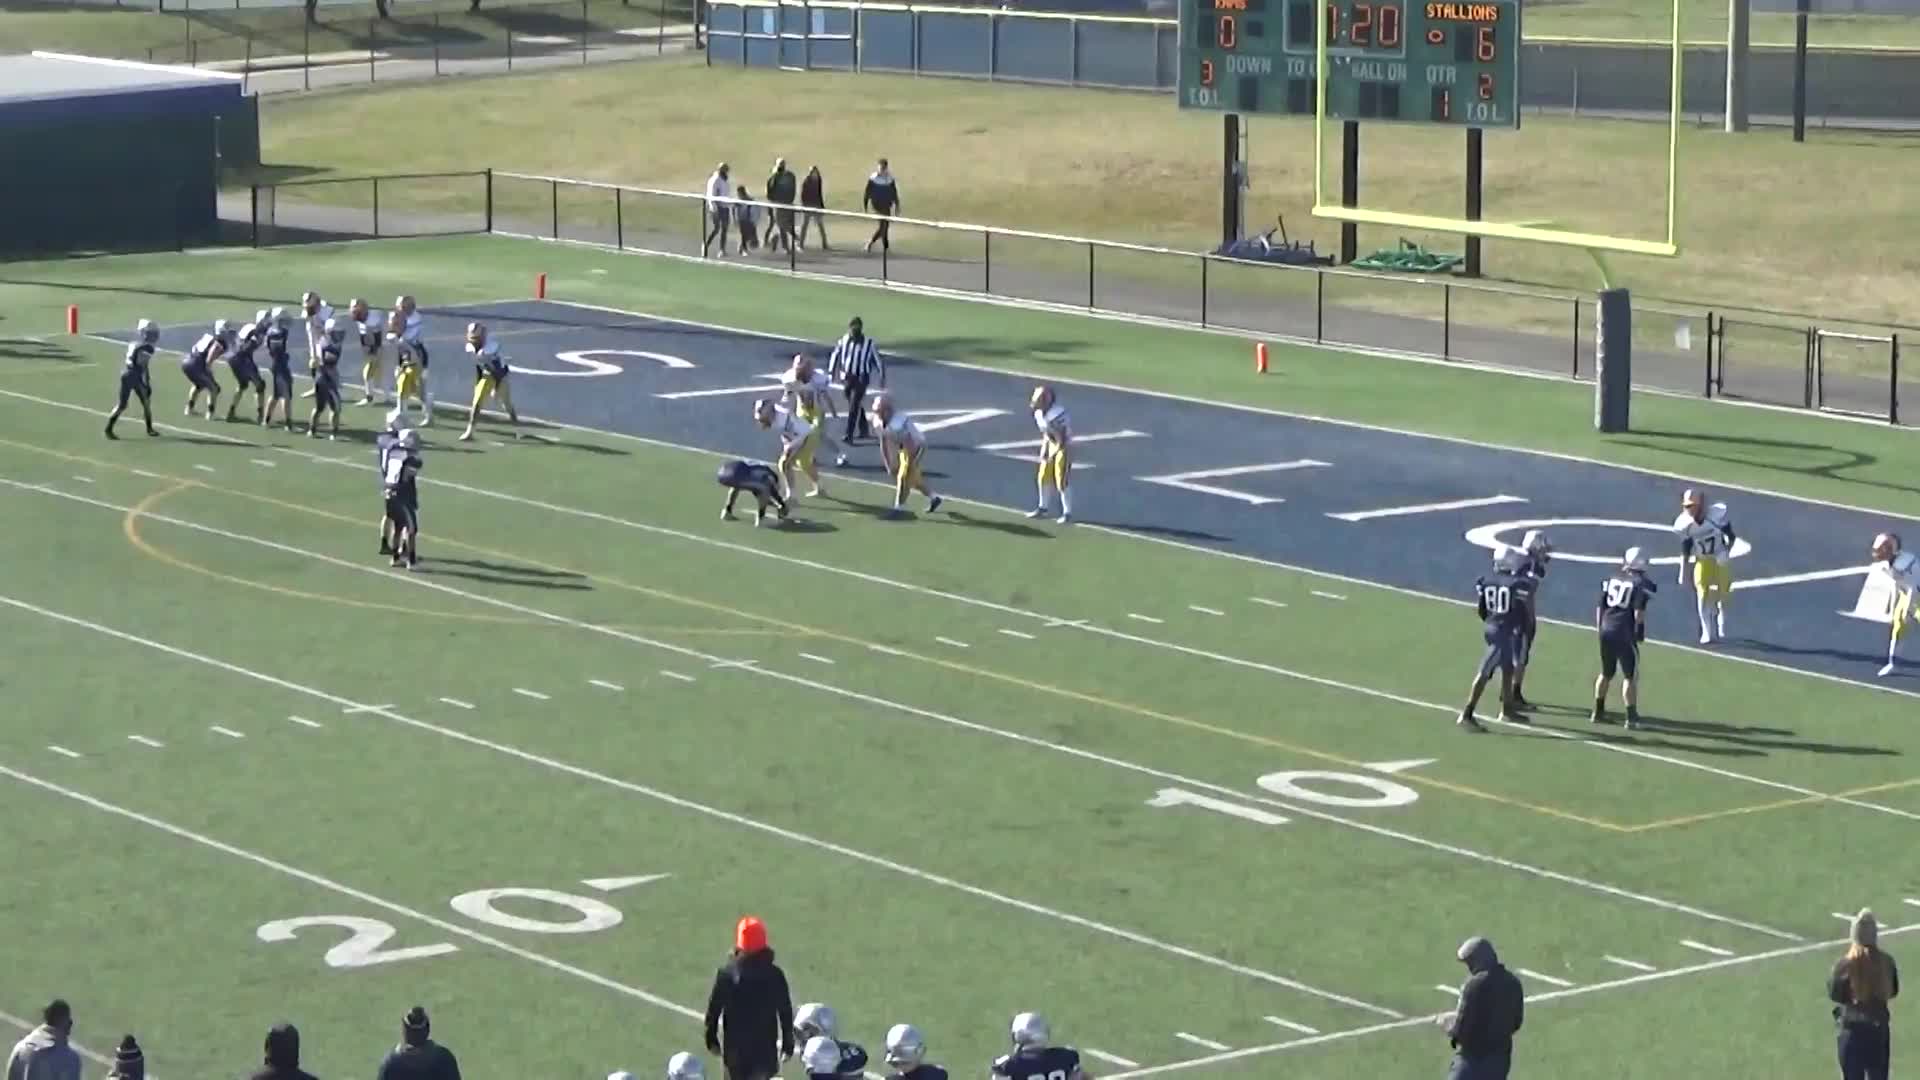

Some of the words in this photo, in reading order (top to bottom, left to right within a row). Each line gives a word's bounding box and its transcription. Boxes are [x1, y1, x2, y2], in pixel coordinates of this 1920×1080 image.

[1427, 3, 1497, 21] STALLIONS
[1220, 16, 1234, 47] 0
[1479, 28, 1494, 60] 6
[1202, 60, 1212, 83] 3
[1226, 55, 1272, 73] DOWN
[1388, 62, 1407, 80] ON
[1426, 65, 1457, 83] QTR
[1480, 74, 1491, 99] 2
[1484, 586, 1511, 614] 80
[1144, 770, 1420, 824] 10
[257, 888, 624, 968] 20
